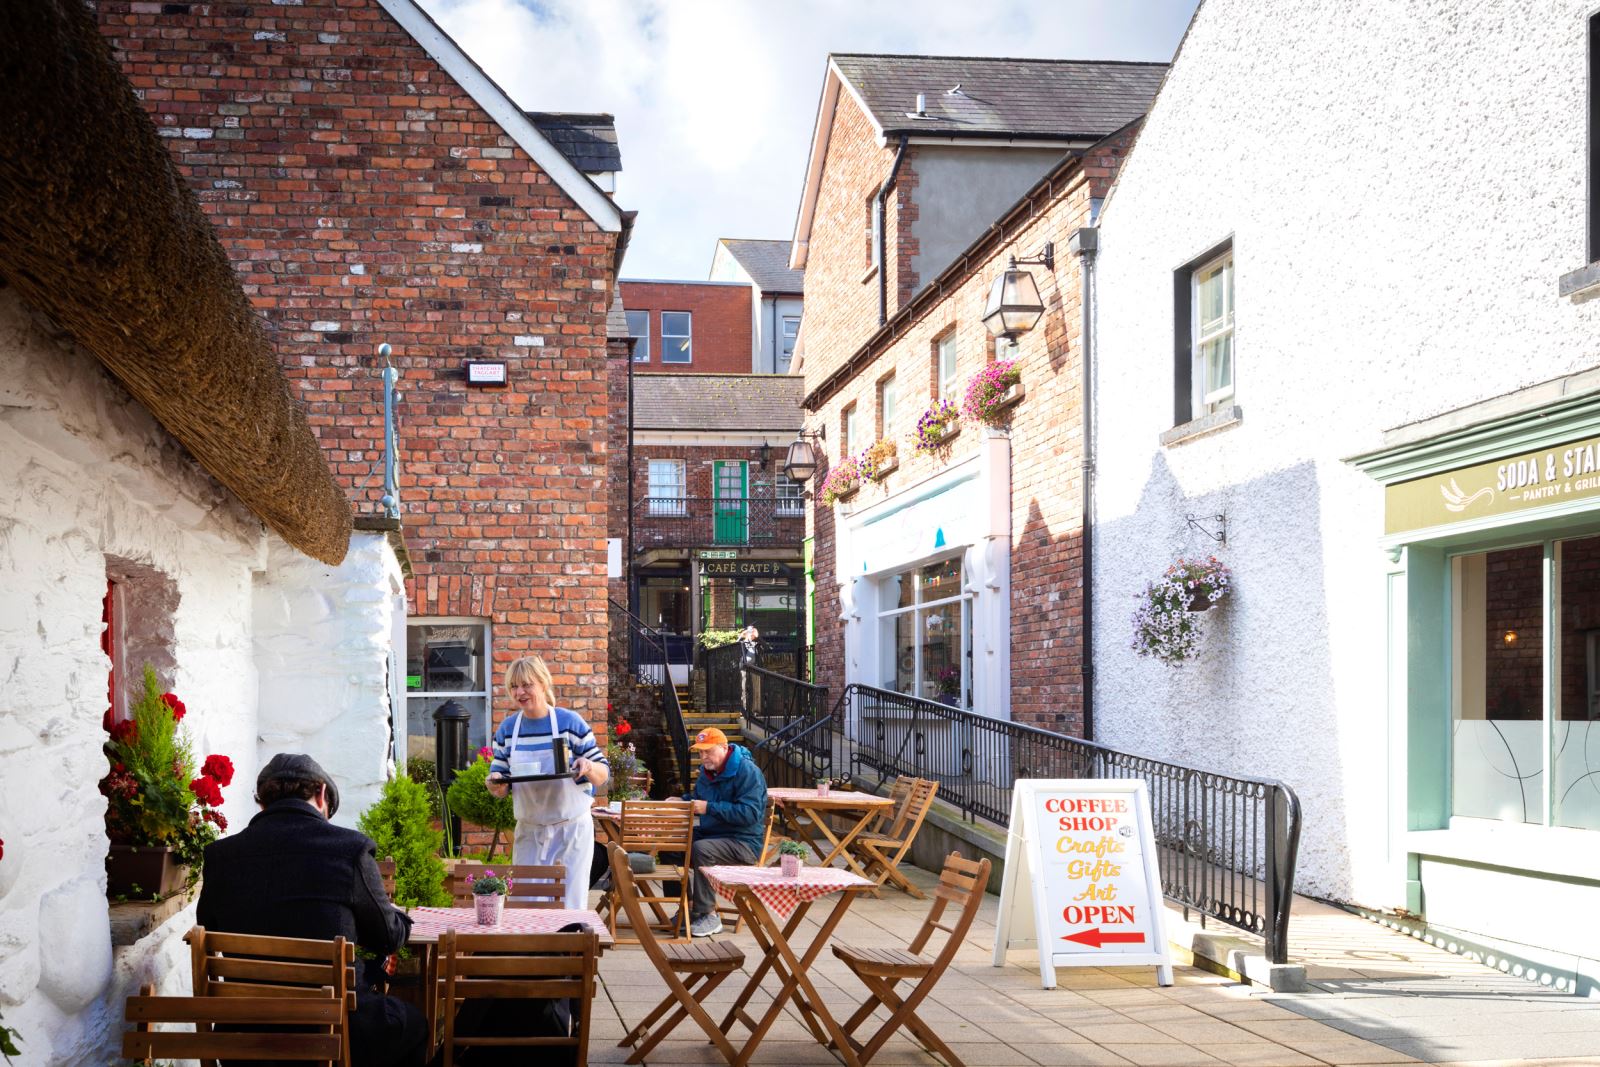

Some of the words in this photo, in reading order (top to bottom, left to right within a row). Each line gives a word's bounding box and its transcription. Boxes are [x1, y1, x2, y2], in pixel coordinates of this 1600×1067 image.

[1497, 457, 1540, 491] SODA
[1545, 453, 1557, 482] &
[1523, 484, 1562, 501] PANTRY
[1564, 482, 1571, 493] &
[707, 562, 737, 573] CAFÉ
[740, 563, 770, 573] GATE
[1045, 798, 1128, 813] COFFEE
[1059, 816, 1119, 831] SHOP
[1056, 835, 1125, 859] Crafts
[1067, 859, 1122, 882] Gifts
[1073, 883, 1119, 901] Art
[1063, 905, 1136, 924] OPEN
